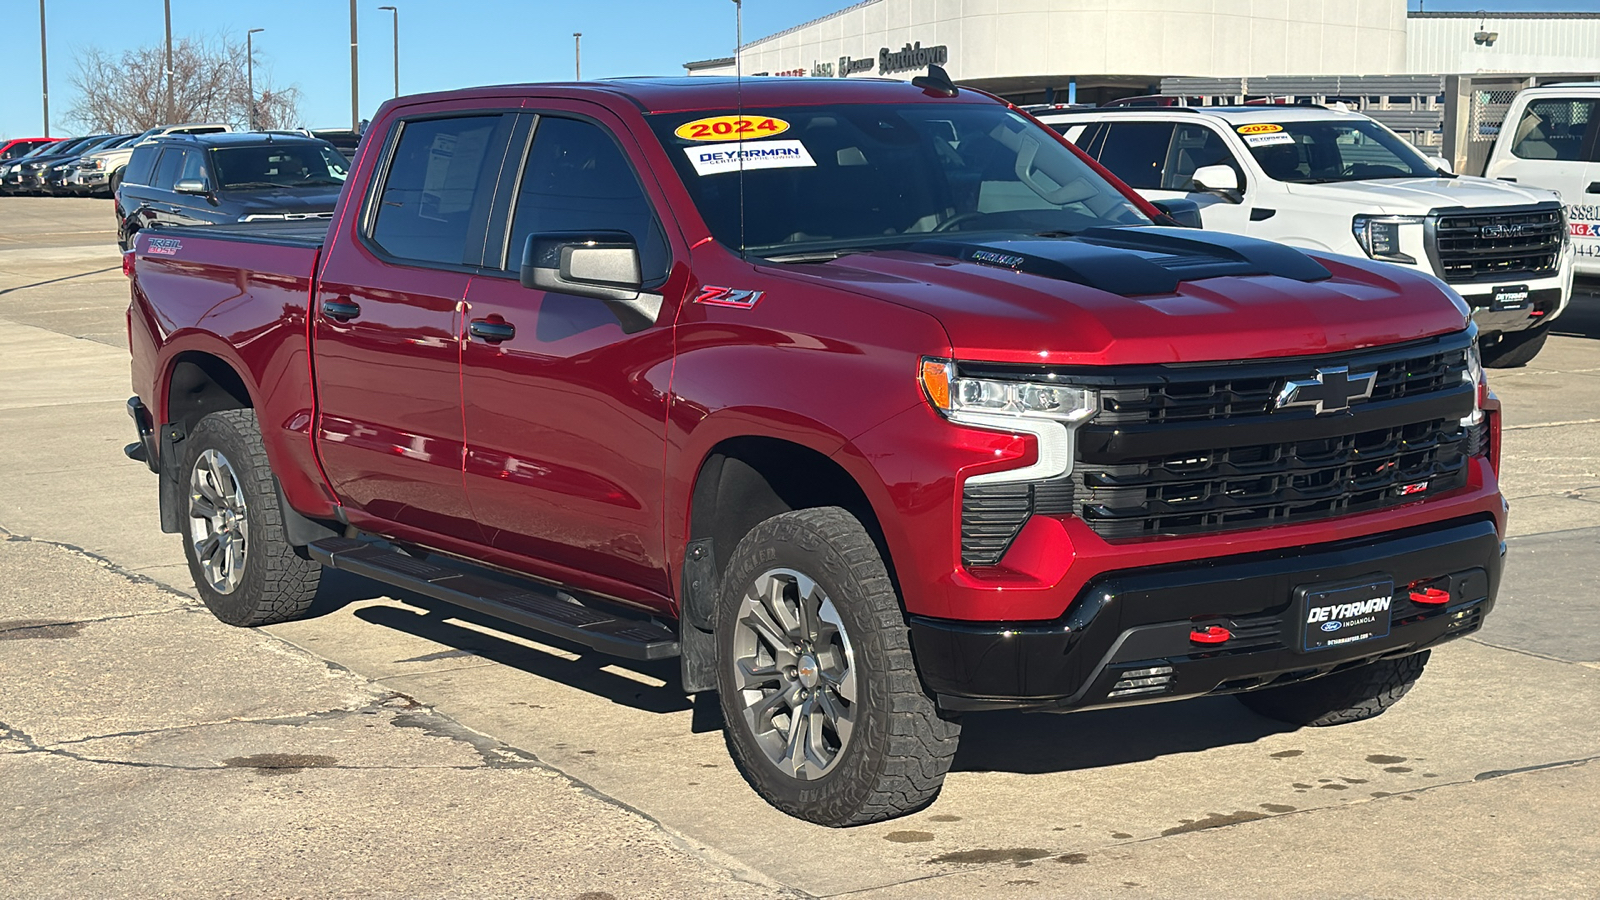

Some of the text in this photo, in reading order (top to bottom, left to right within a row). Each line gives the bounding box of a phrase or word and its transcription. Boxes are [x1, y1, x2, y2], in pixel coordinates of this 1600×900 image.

[879, 41, 948, 76] Southtown
[690, 119, 779, 138] 2024
[1243, 125, 1279, 133] 2023
[700, 148, 799, 162] DEYARMAN
[1482, 224, 1535, 238] GMC
[693, 284, 766, 310] Z71
[1307, 596, 1392, 623] DEYARMAN
[1343, 616, 1376, 627] INDIANOLA
